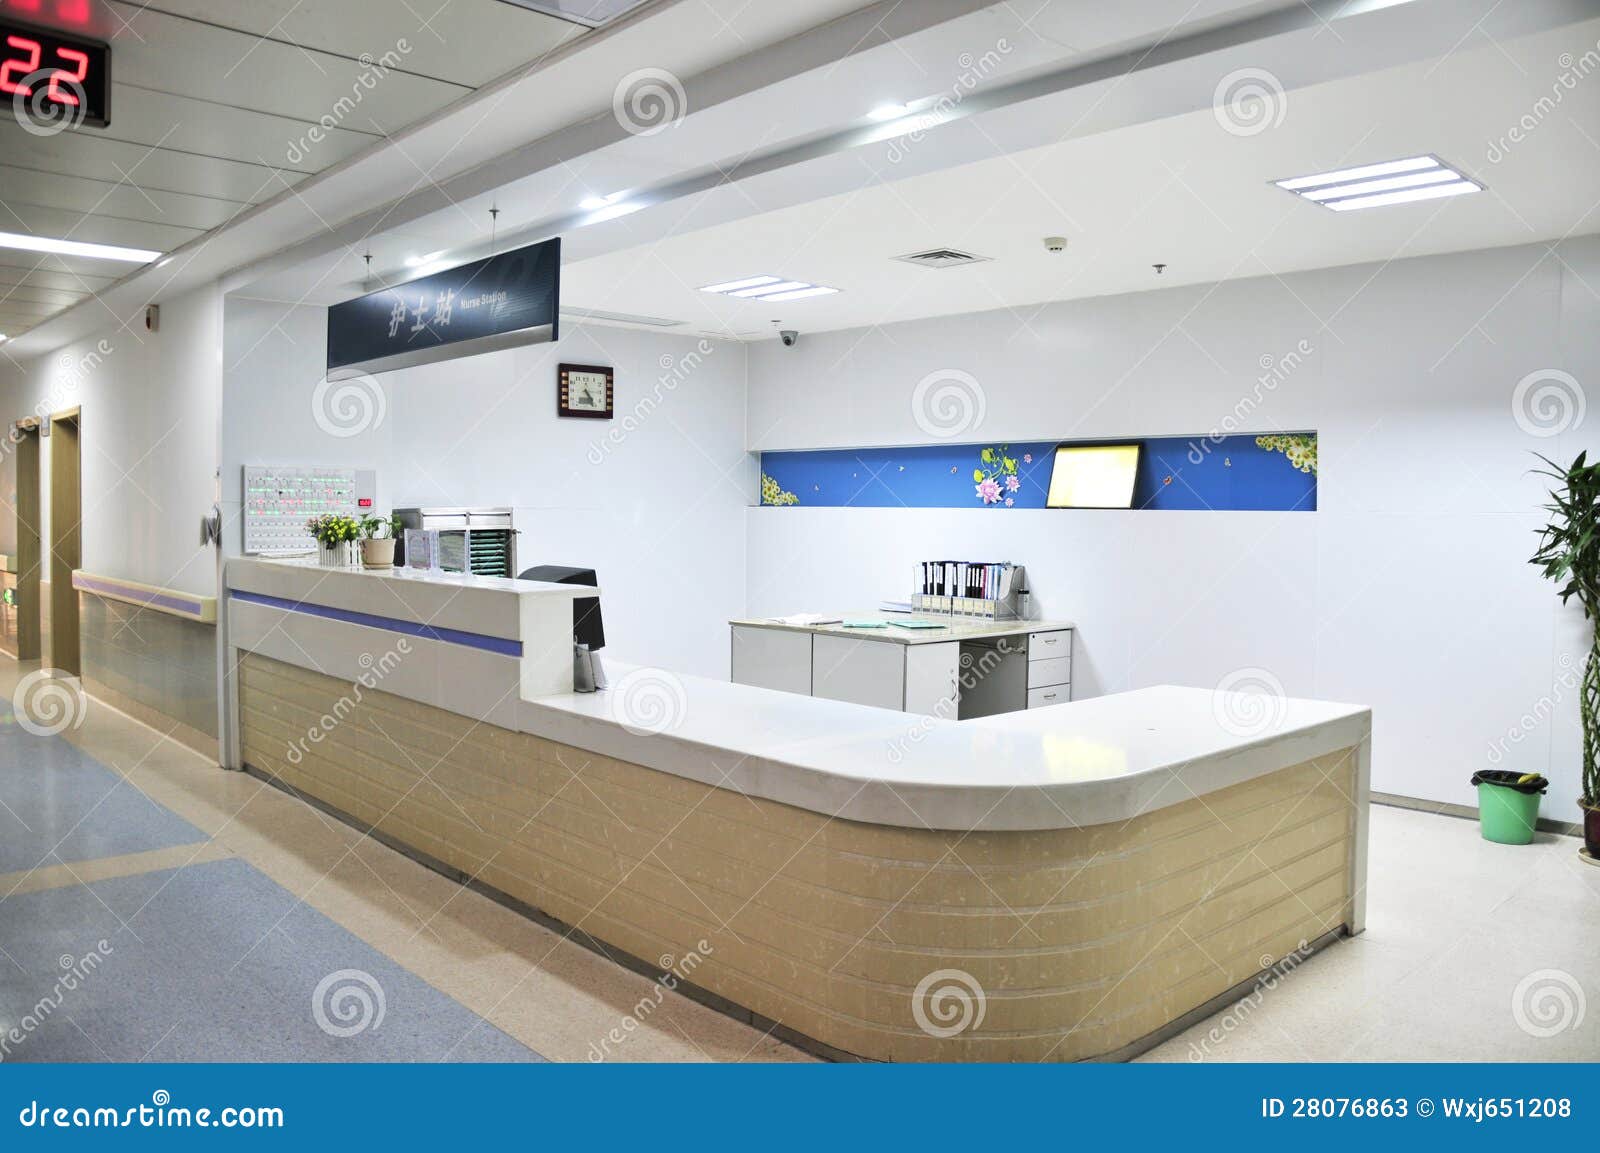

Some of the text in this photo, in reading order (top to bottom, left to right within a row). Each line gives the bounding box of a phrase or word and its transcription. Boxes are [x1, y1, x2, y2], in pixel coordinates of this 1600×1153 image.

[0, 35, 88, 106] 22
[388, 287, 455, 338] 护士站
[461, 290, 507, 309] Nurse Station
